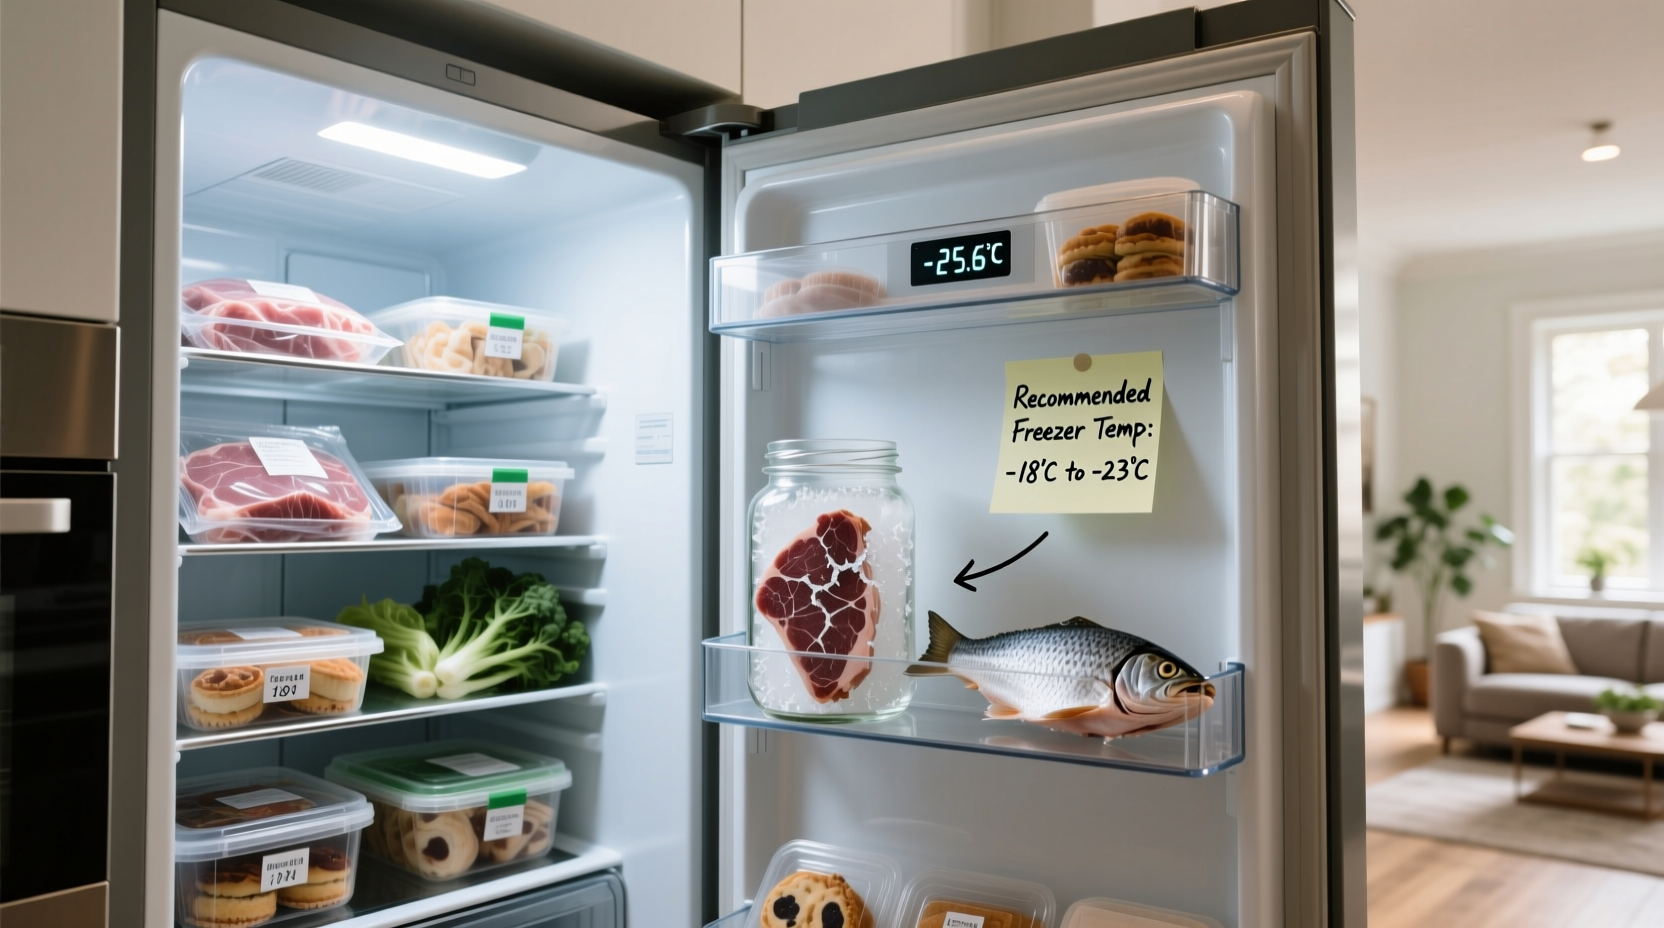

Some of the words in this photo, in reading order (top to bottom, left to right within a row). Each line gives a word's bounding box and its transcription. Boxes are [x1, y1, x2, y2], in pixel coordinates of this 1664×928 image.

[1013, 377, 1152, 409] Recommended
[1012, 417, 1086, 443] Freezer
[1093, 415, 1154, 448] Temp:
[1065, 460, 1086, 482] to
[1092, 455, 1150, 482] -23°C
